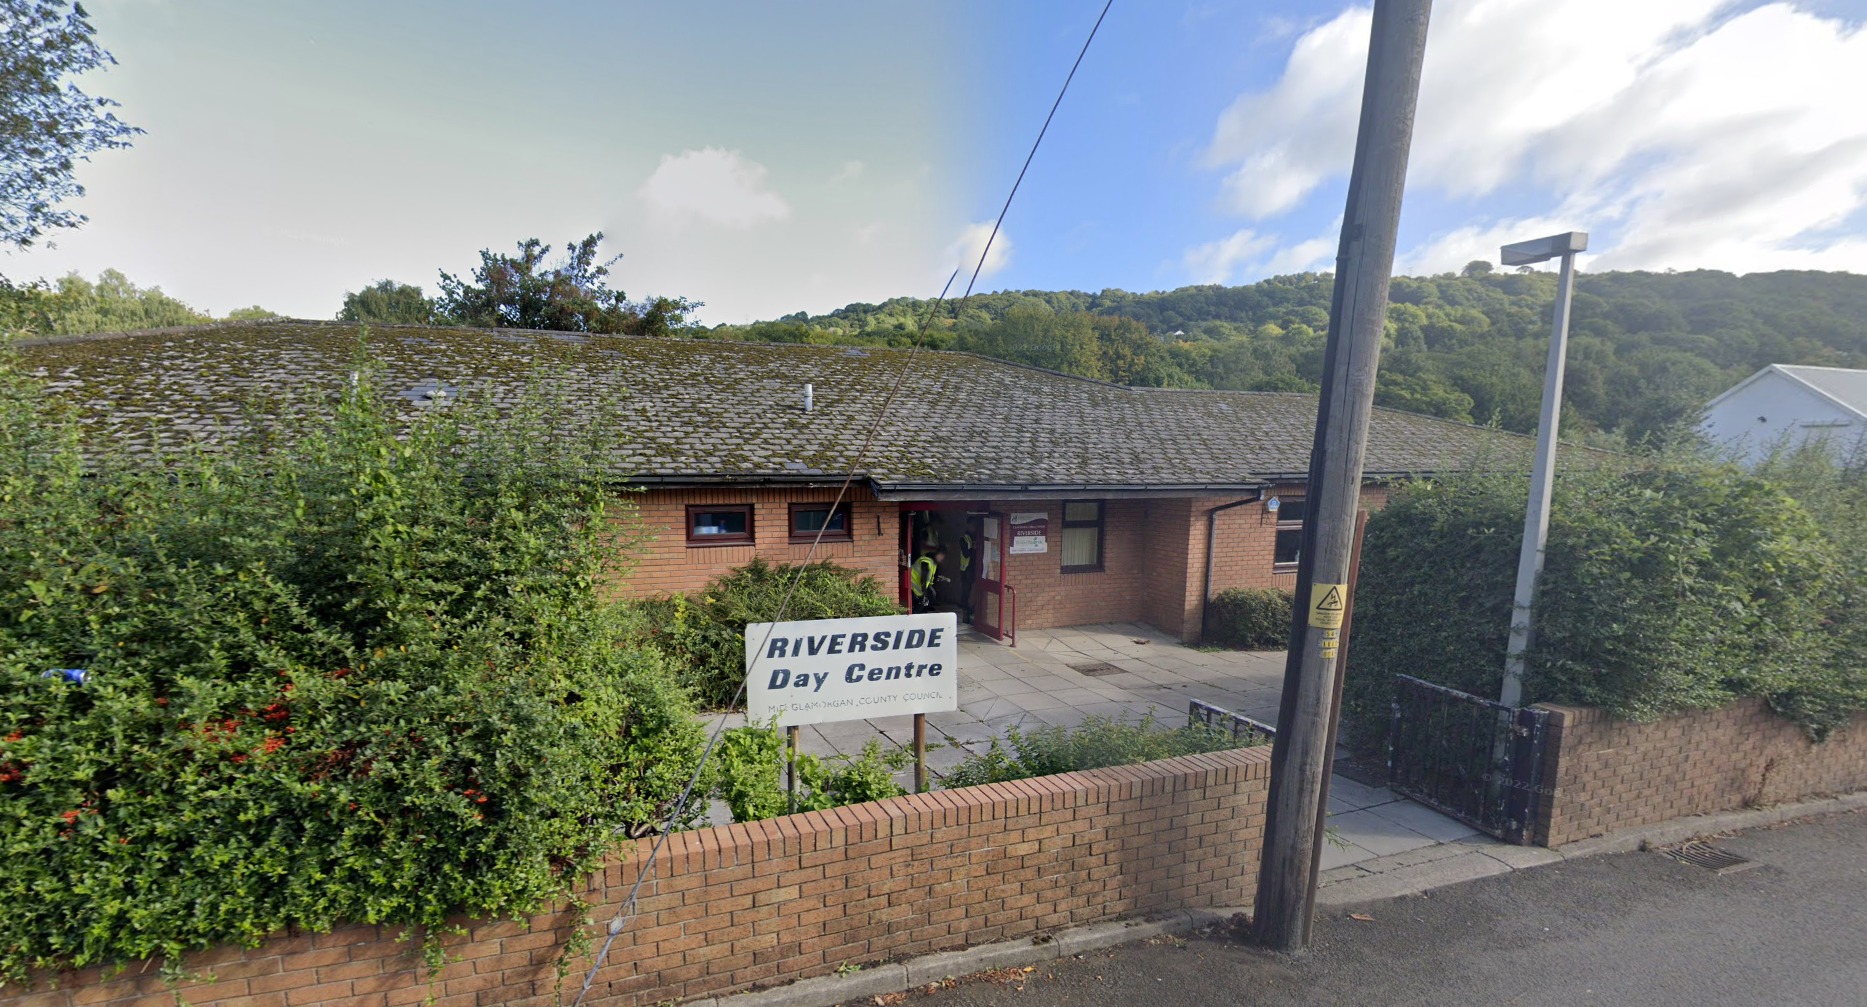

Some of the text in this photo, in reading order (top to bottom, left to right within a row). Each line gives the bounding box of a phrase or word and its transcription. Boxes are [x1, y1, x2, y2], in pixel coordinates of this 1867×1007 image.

[766, 627, 945, 659] RIVERSIDE
[767, 661, 943, 693] Day Centre
[791, 698, 854, 712] GLAMORGAN
[858, 694, 898, 705] COUNTY
[902, 691, 943, 703] COUNCIL
